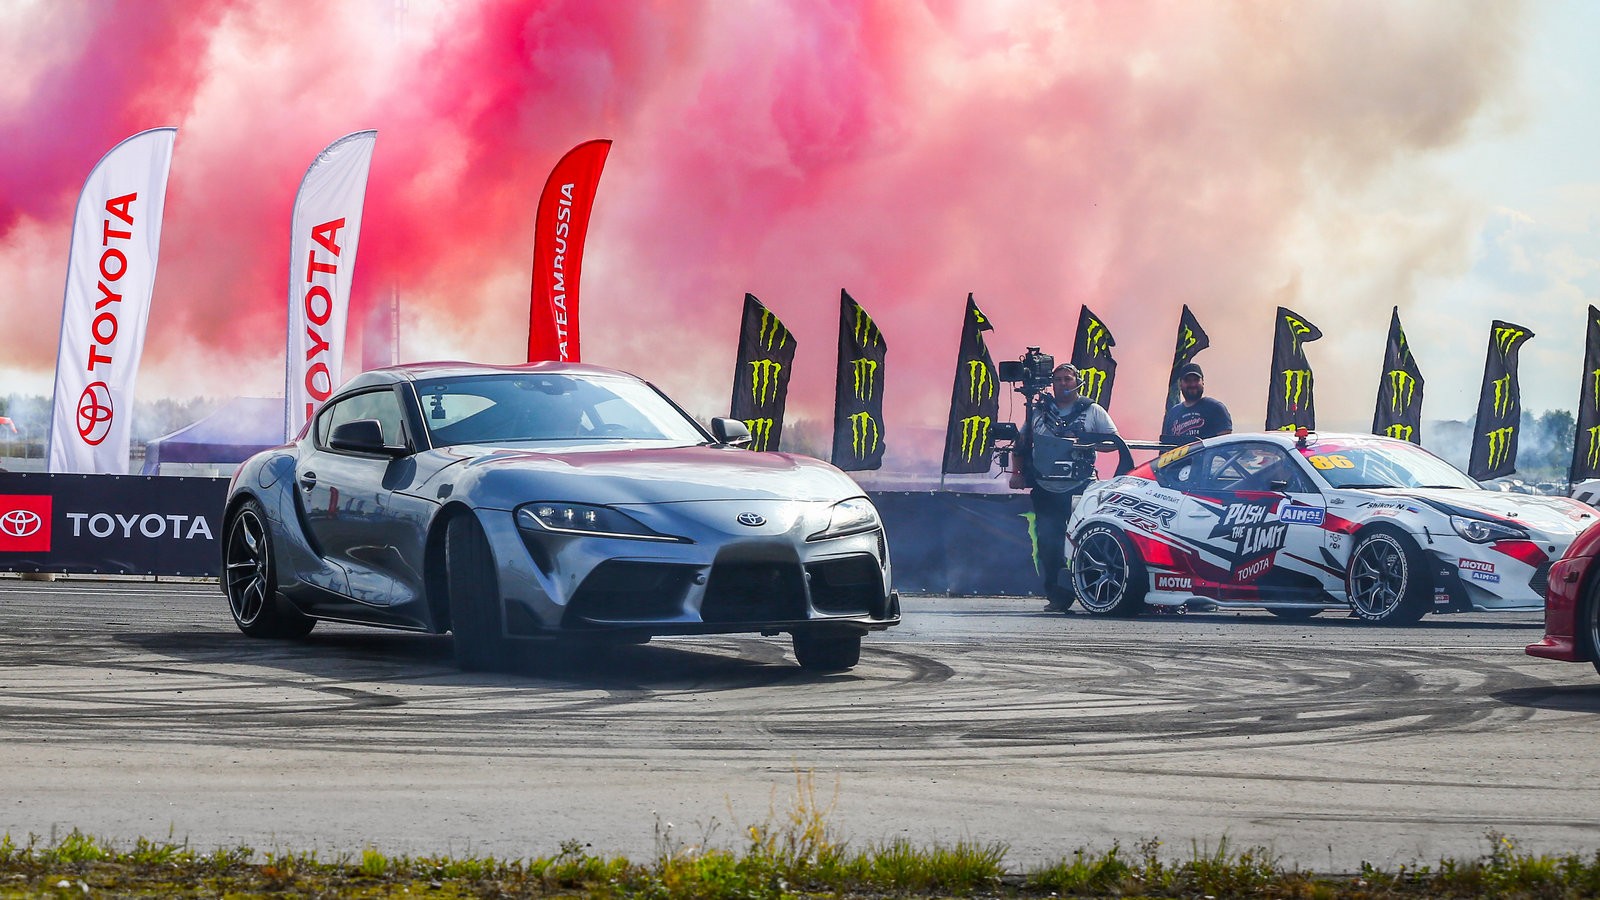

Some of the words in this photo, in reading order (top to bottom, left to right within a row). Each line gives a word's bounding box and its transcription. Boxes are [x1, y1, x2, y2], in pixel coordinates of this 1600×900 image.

[87, 192, 137, 371] TOYOTA
[553, 183, 575, 362] ATEAMRUSSIA
[1308, 454, 1355, 470] 86
[1098, 490, 1178, 529] VIPER
[1223, 503, 1266, 526] PUSH
[1281, 508, 1321, 521] AIMOL
[66, 512, 214, 540] TOYOTA
[1232, 526, 1246, 539] THE
[1241, 525, 1286, 556] LIMIT
[1238, 557, 1270, 581] TOYOTA
[1460, 560, 1494, 572] MOTUL
[1158, 576, 1193, 589] MOTUL
